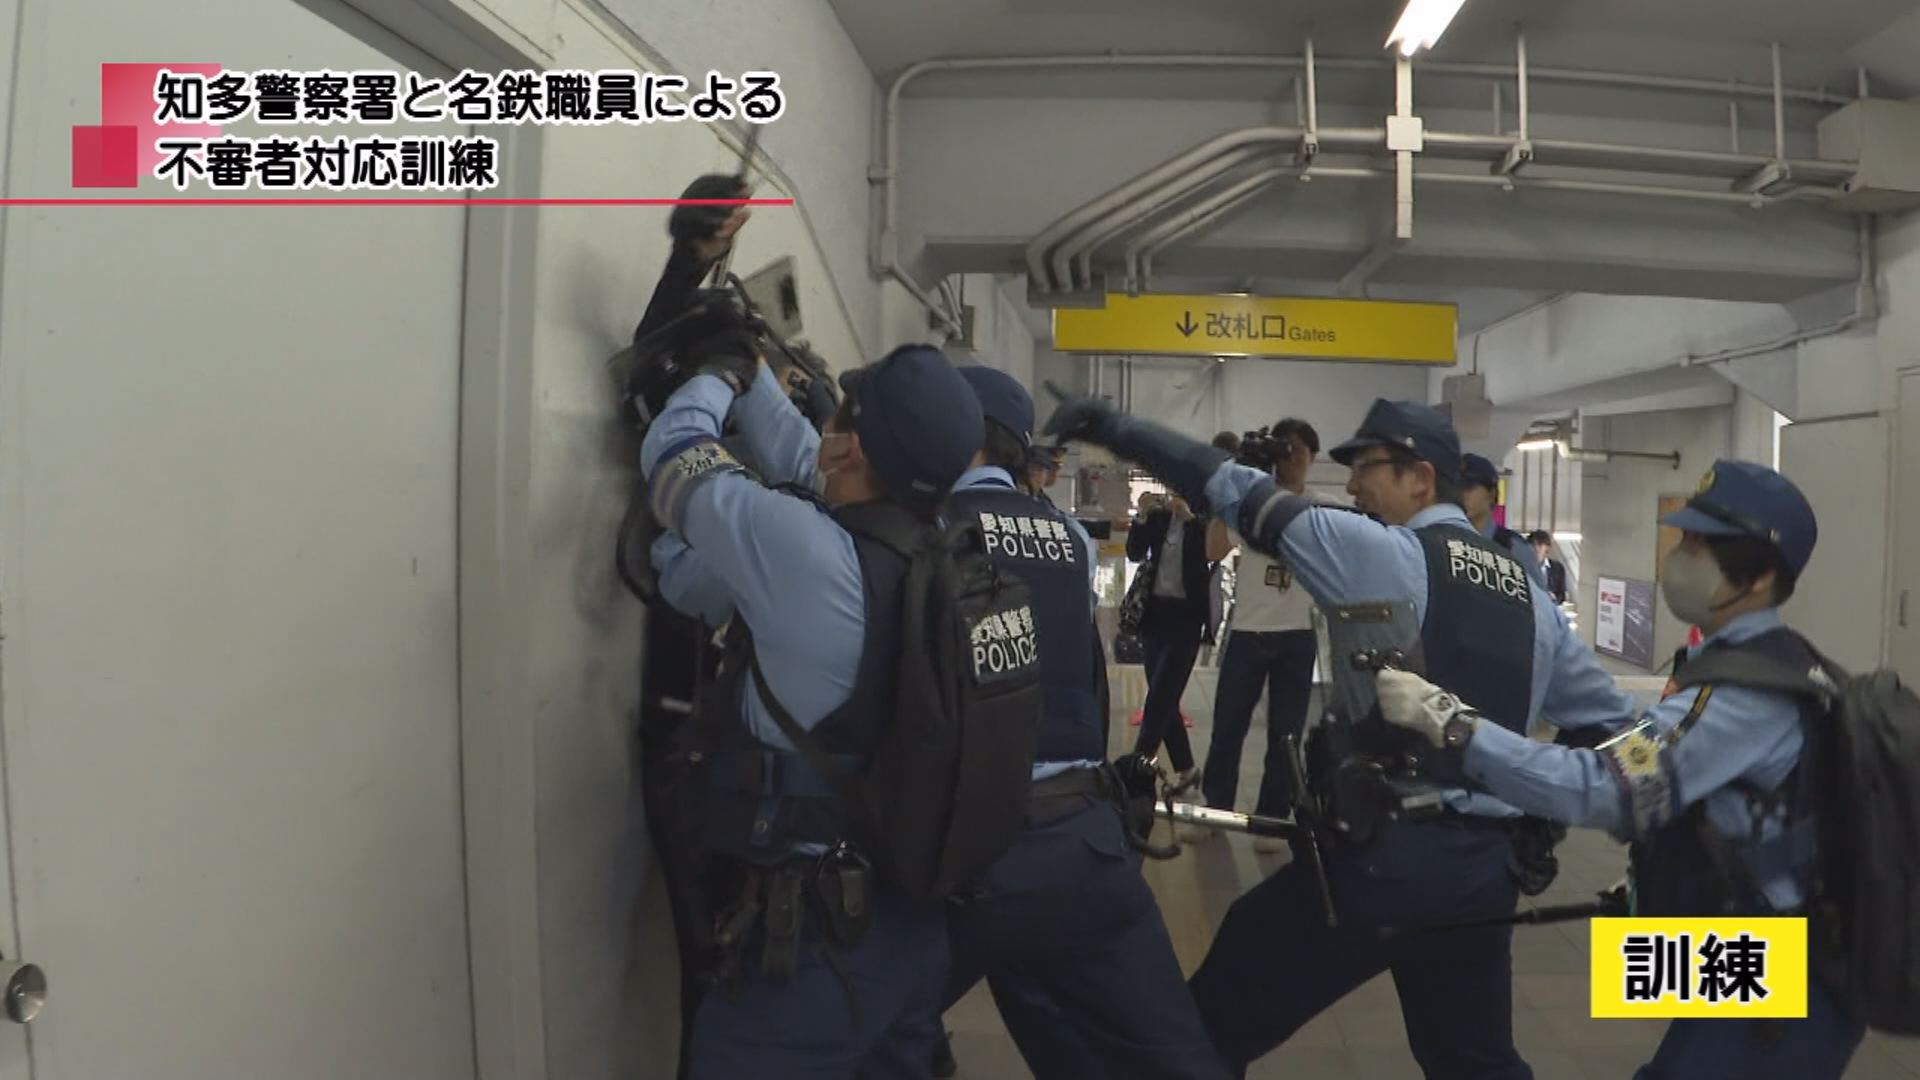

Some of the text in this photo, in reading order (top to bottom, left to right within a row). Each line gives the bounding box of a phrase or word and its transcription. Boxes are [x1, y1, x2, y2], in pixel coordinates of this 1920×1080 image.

[1206, 312, 1336, 342] 改札口 Gates
[984, 533, 1075, 563] POLICE
[1451, 557, 1529, 603] POLICE
[973, 633, 1038, 677] POLICE
